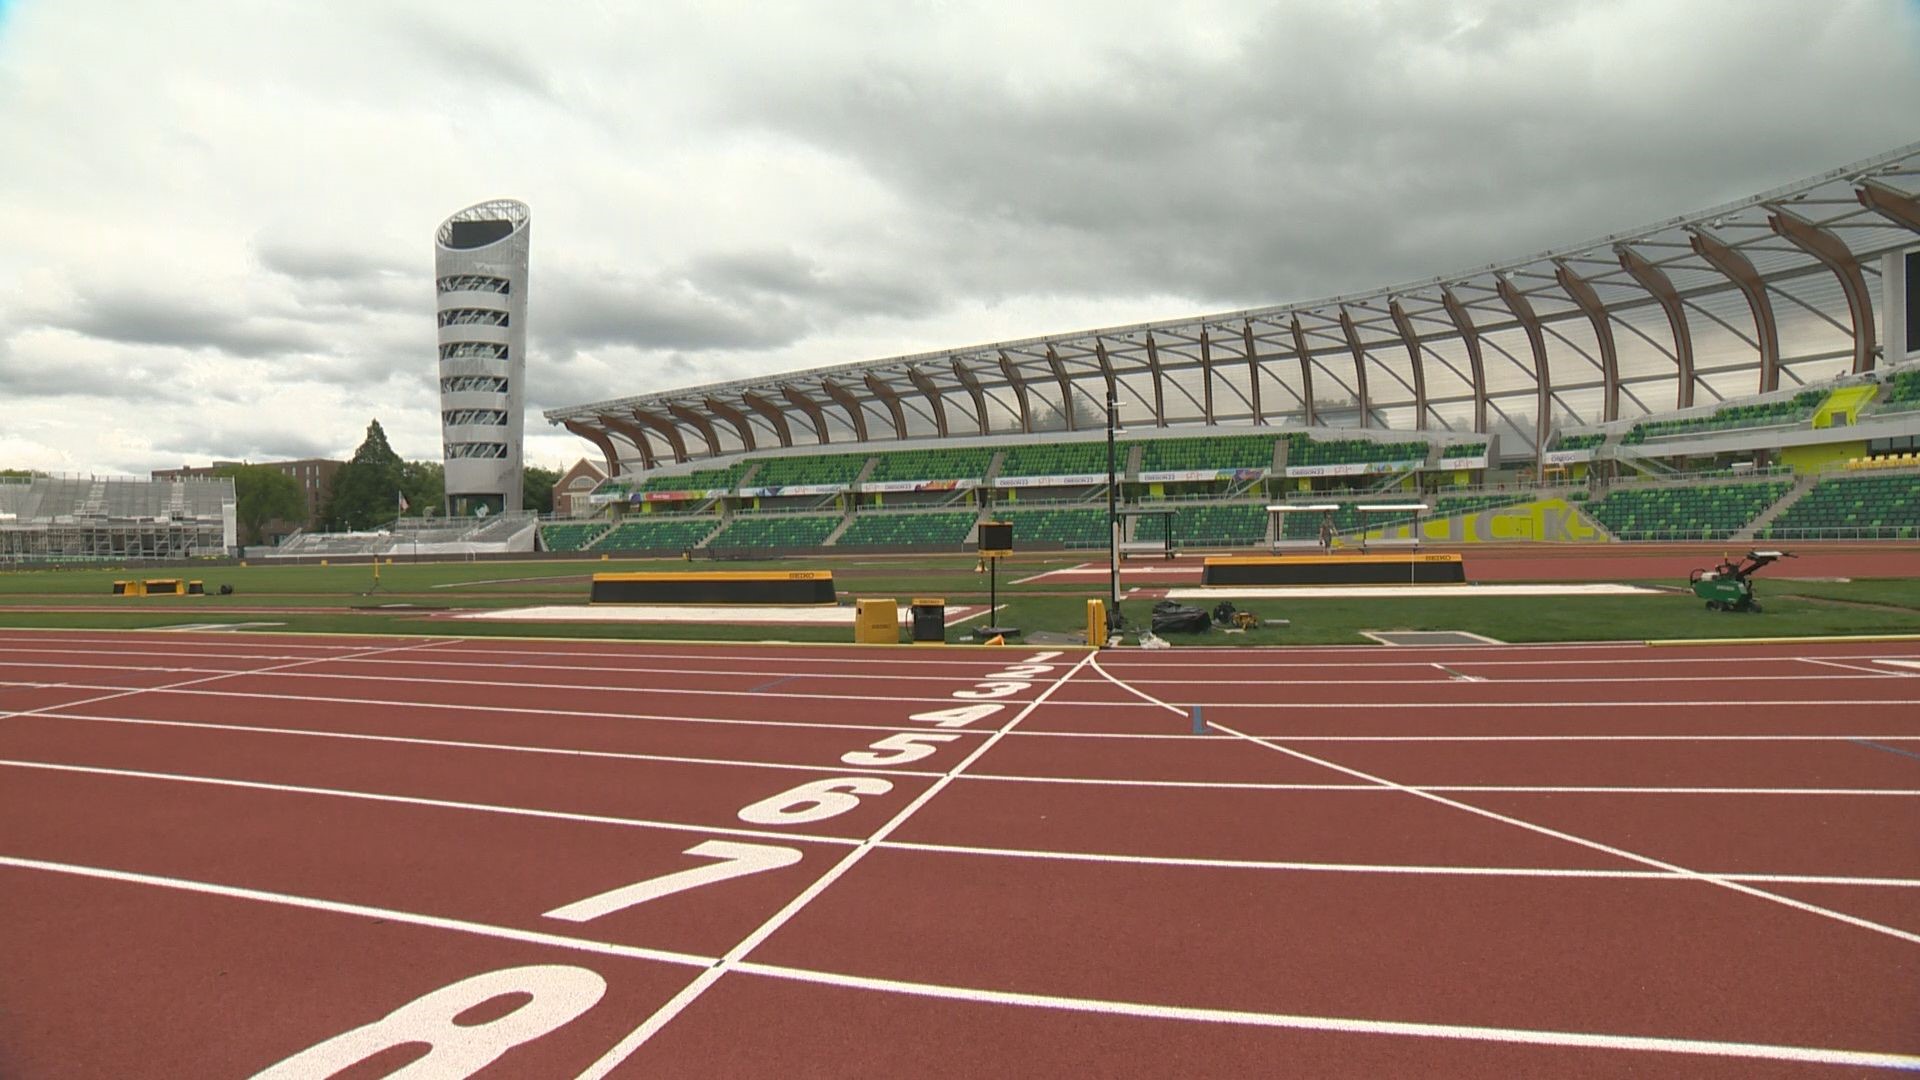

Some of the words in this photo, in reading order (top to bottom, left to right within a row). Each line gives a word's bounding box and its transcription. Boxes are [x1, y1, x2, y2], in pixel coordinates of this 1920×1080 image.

[789, 572, 815, 580] SEIKO
[1022, 651, 1064, 663] 1
[985, 665, 1055, 679] 2
[952, 681, 1032, 699] 3
[909, 703, 1005, 728] 4
[840, 732, 962, 766] 5
[738, 777, 894, 825] 6
[542, 839, 804, 923] 7
[248, 964, 607, 1080] 8
